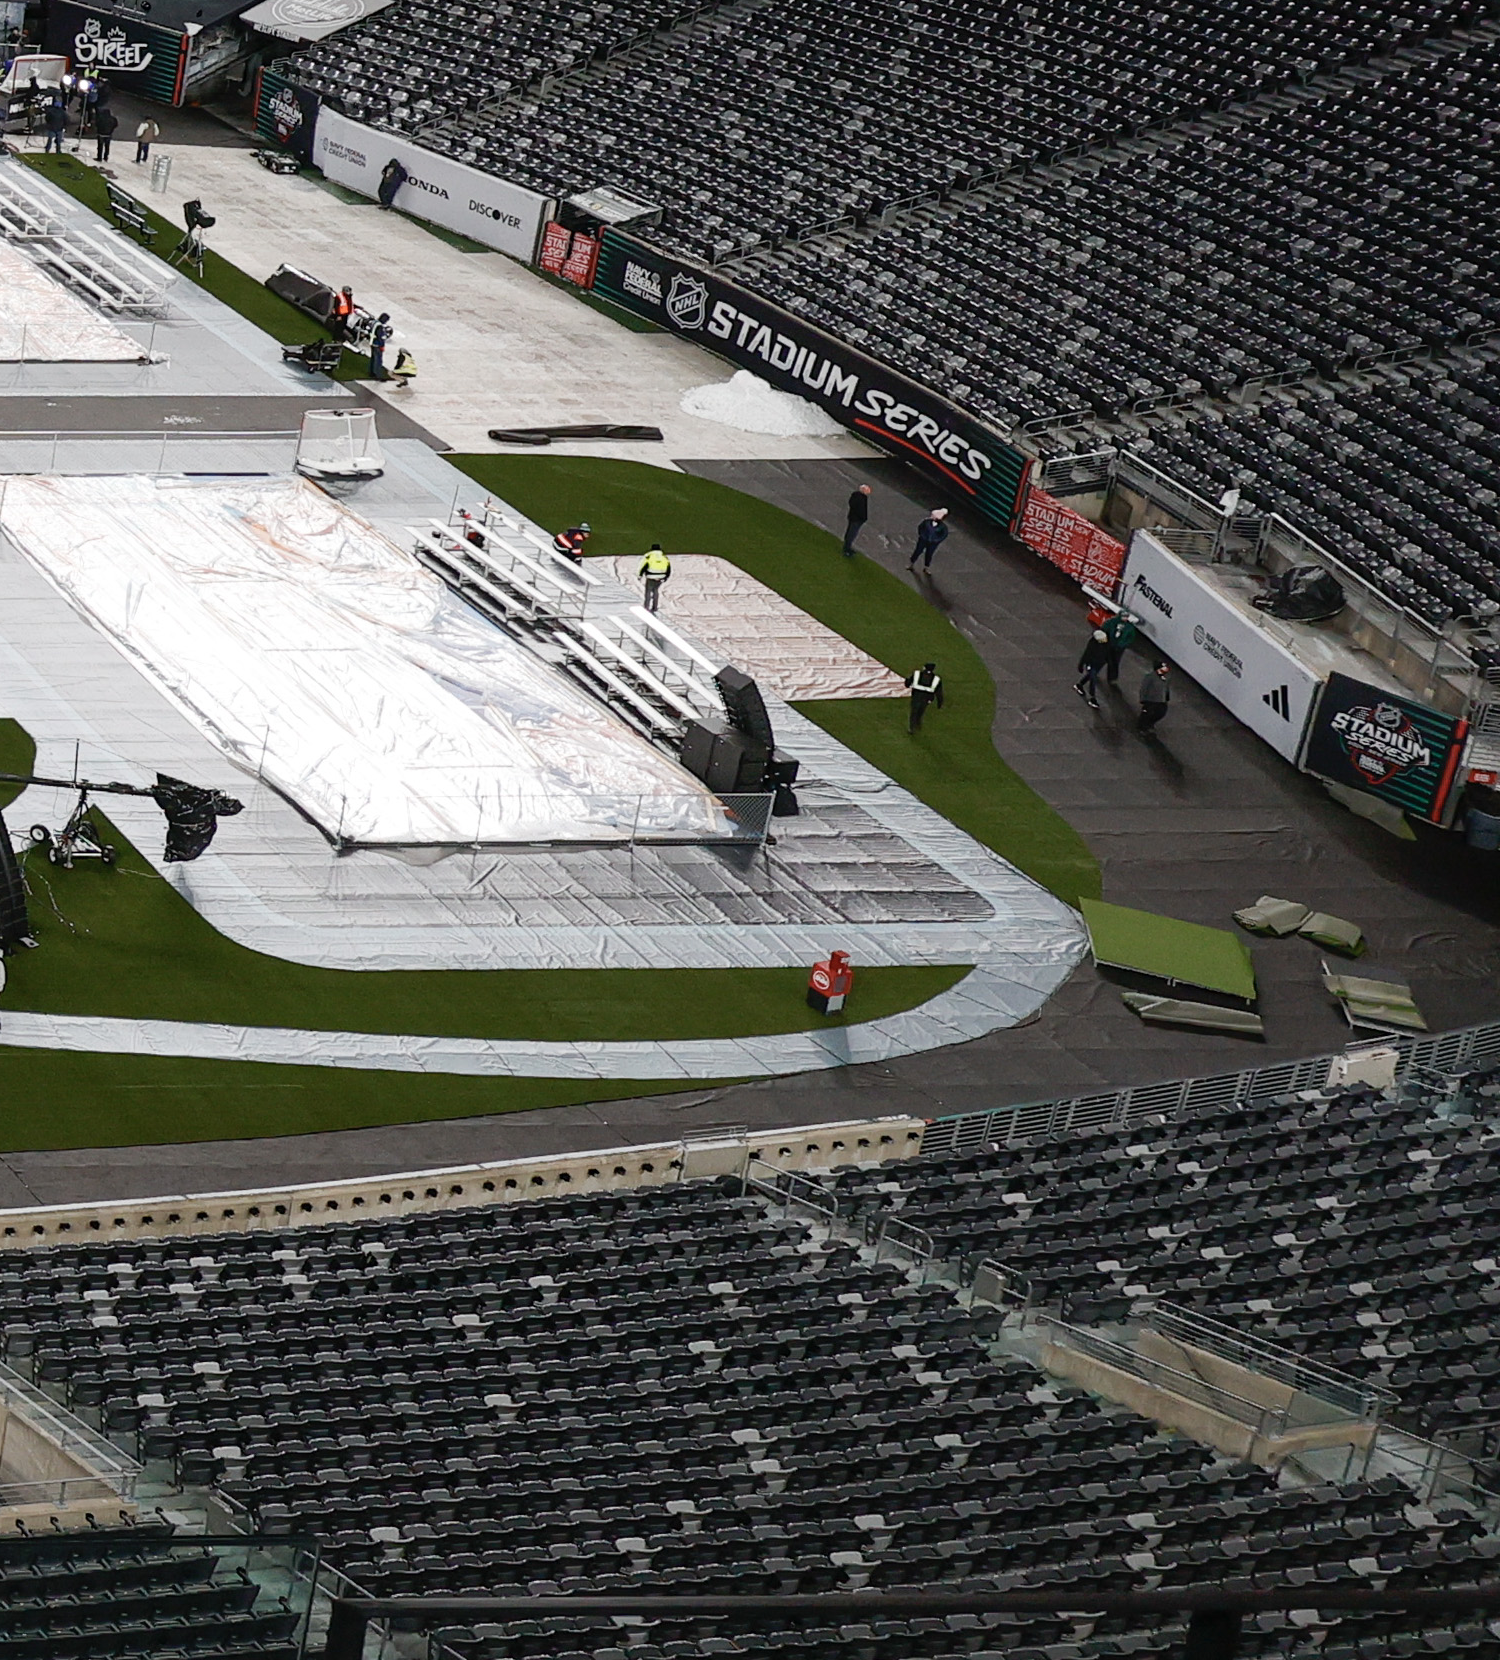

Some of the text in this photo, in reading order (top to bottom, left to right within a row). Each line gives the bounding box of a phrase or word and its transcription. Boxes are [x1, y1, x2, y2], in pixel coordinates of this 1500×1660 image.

[75, 32, 149, 70] STREET
[468, 198, 522, 230] DISCOVER
[674, 293, 994, 481] NHL STADIUM SERIES
[1133, 573, 1173, 619] FASTENAL
